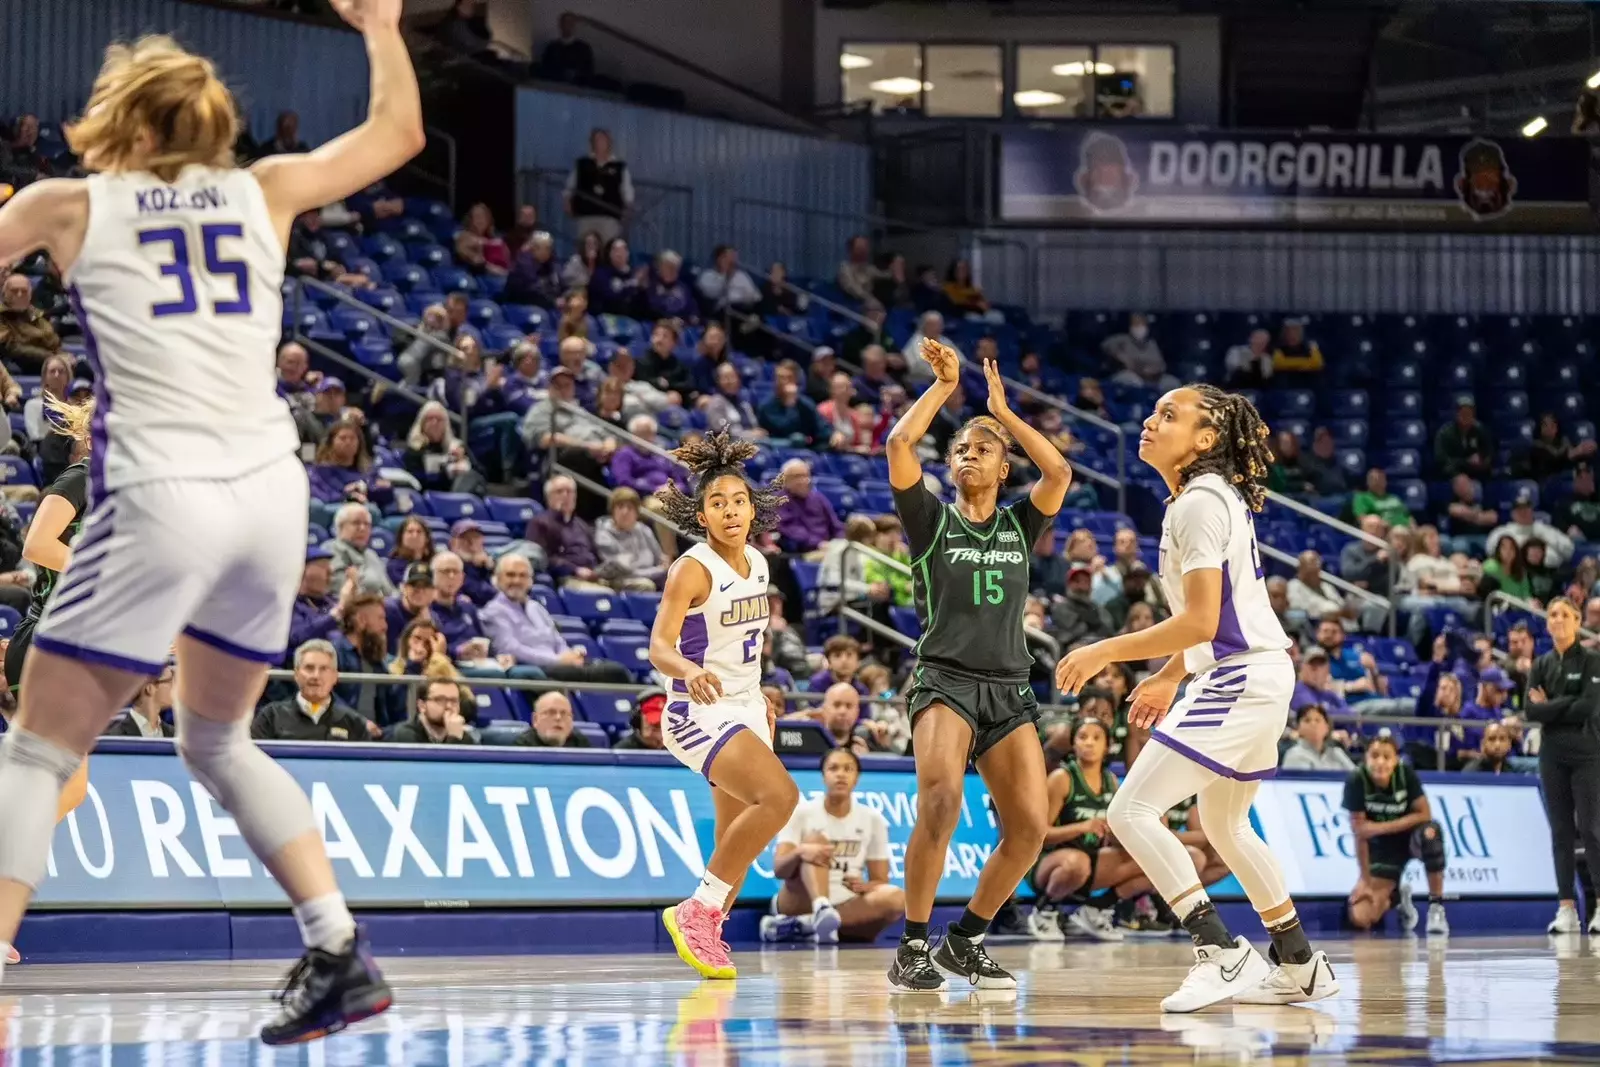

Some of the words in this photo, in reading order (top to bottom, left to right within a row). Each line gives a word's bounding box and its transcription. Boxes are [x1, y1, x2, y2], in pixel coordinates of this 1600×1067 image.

[1149, 139, 1444, 190] DOORGORILLA
[136, 221, 254, 318] 35
[973, 569, 1005, 606] 15
[742, 627, 761, 664] 2
[131, 779, 705, 880] REAXATION
[1447, 866, 1500, 883] RRIOTT
